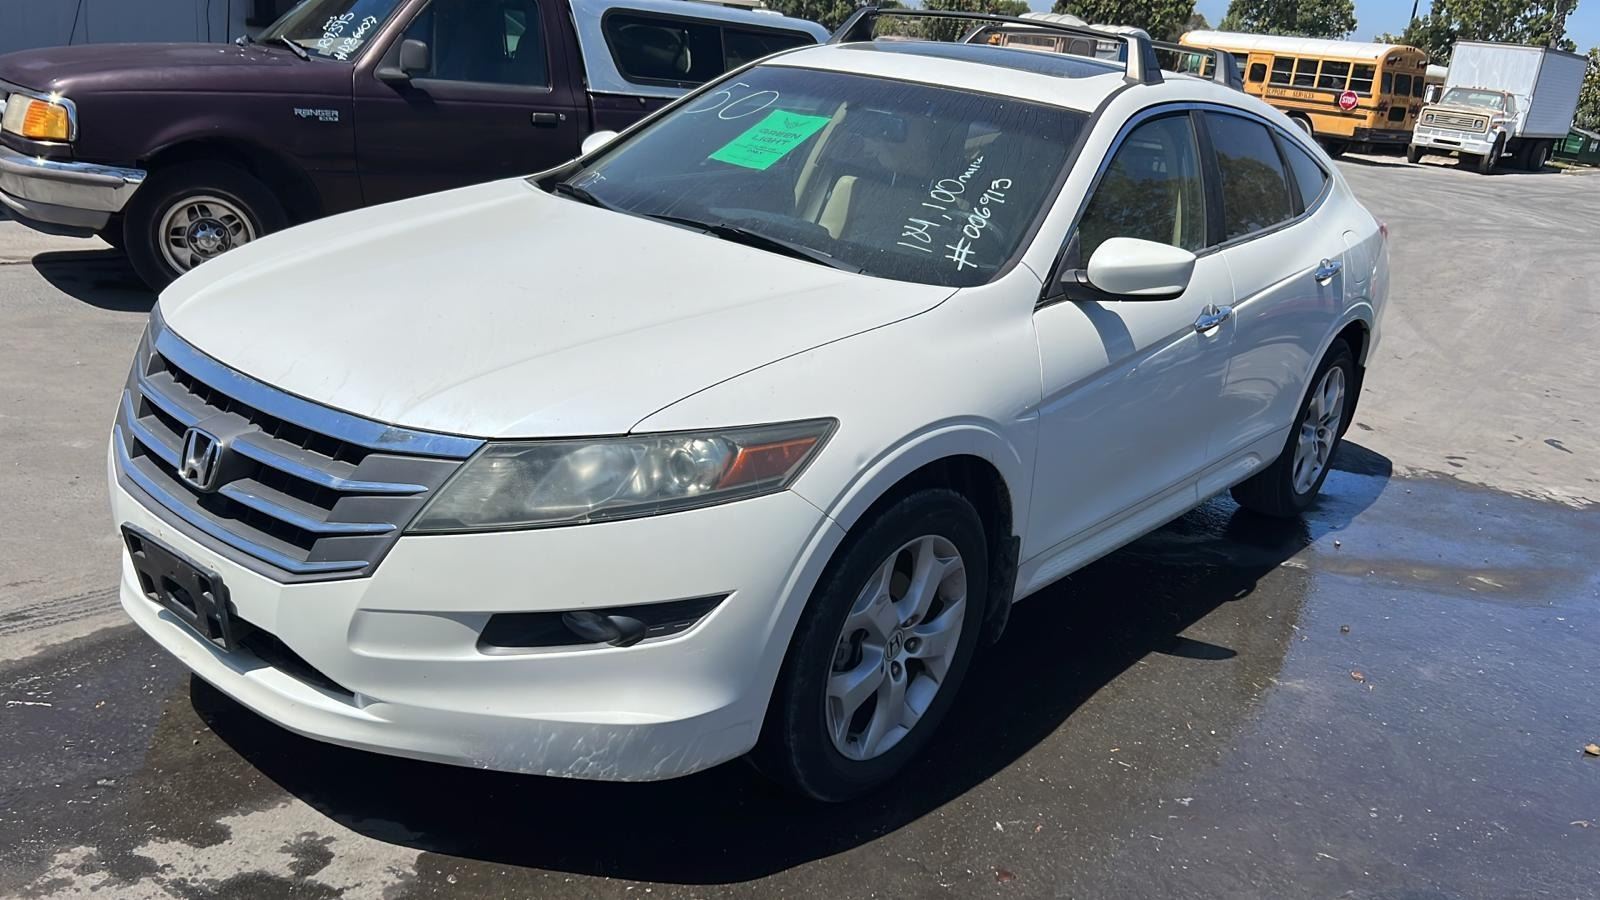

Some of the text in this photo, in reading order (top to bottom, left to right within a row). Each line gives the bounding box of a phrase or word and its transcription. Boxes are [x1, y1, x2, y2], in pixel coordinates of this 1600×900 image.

[684, 82, 780, 120] 50
[1341, 95, 1357, 105] STOP
[293, 107, 339, 118] RANGER
[759, 128, 803, 139] GREEN
[752, 134, 792, 146] LIGHT
[945, 178, 1013, 271] #006913
